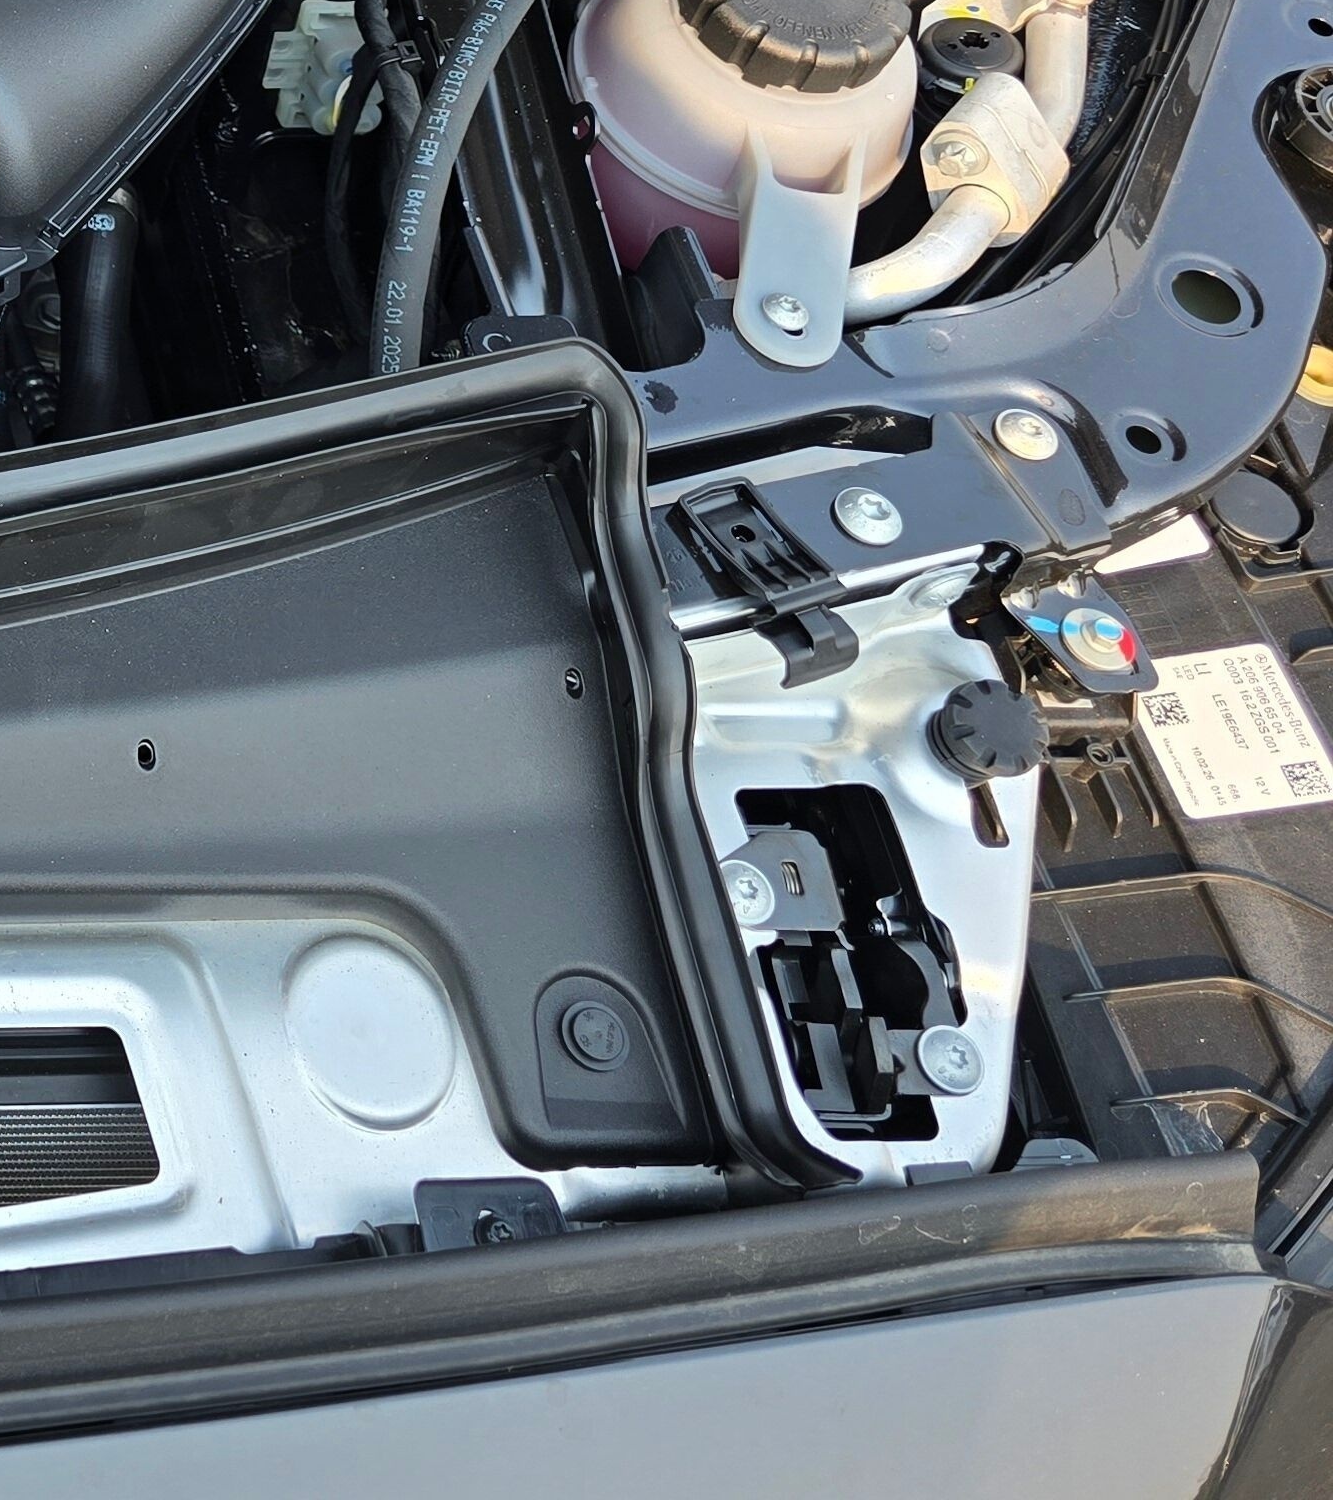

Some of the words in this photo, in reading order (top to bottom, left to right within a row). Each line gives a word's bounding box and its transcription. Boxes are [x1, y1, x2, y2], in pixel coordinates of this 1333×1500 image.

[394, 187, 428, 254] BA119-1
[1236, 655, 1248, 665] A
[1181, 664, 1196, 682] LED
[1241, 665, 1261, 685] 206
[1260, 663, 1311, 749] Mercedes-Benz
[1263, 704, 1279, 720] 65
[1270, 720, 1287, 736] 04
[1190, 744, 1216, 782] 10.02.26
[1254, 775, 1267, 788] 12
[1259, 786, 1272, 797] V
